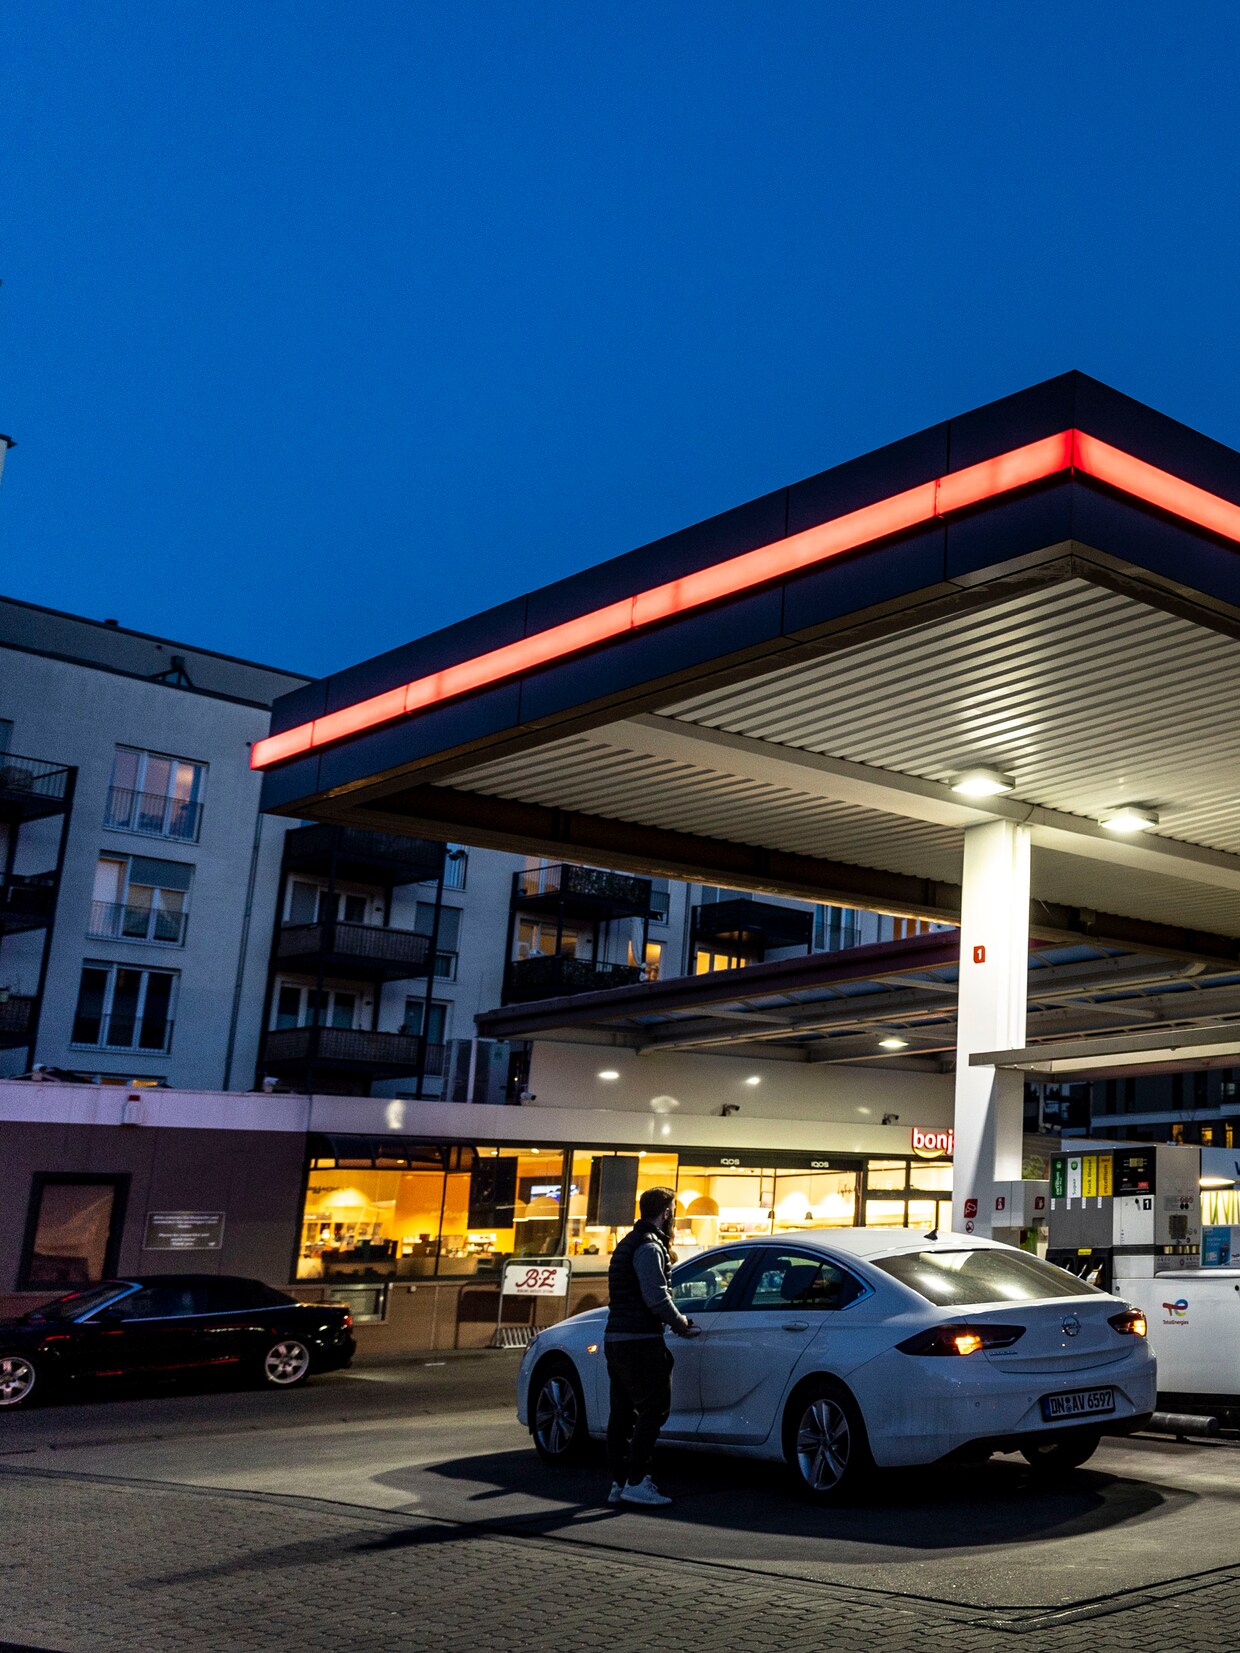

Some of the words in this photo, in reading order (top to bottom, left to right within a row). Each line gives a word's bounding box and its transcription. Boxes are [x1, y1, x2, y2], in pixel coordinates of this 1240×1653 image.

[976, 948, 983, 961] 1
[912, 1127, 955, 1155] bonj
[1051, 1396, 1065, 1414] DN
[1072, 1394, 1085, 1412] AV
[1087, 1391, 1112, 1409] 6597
